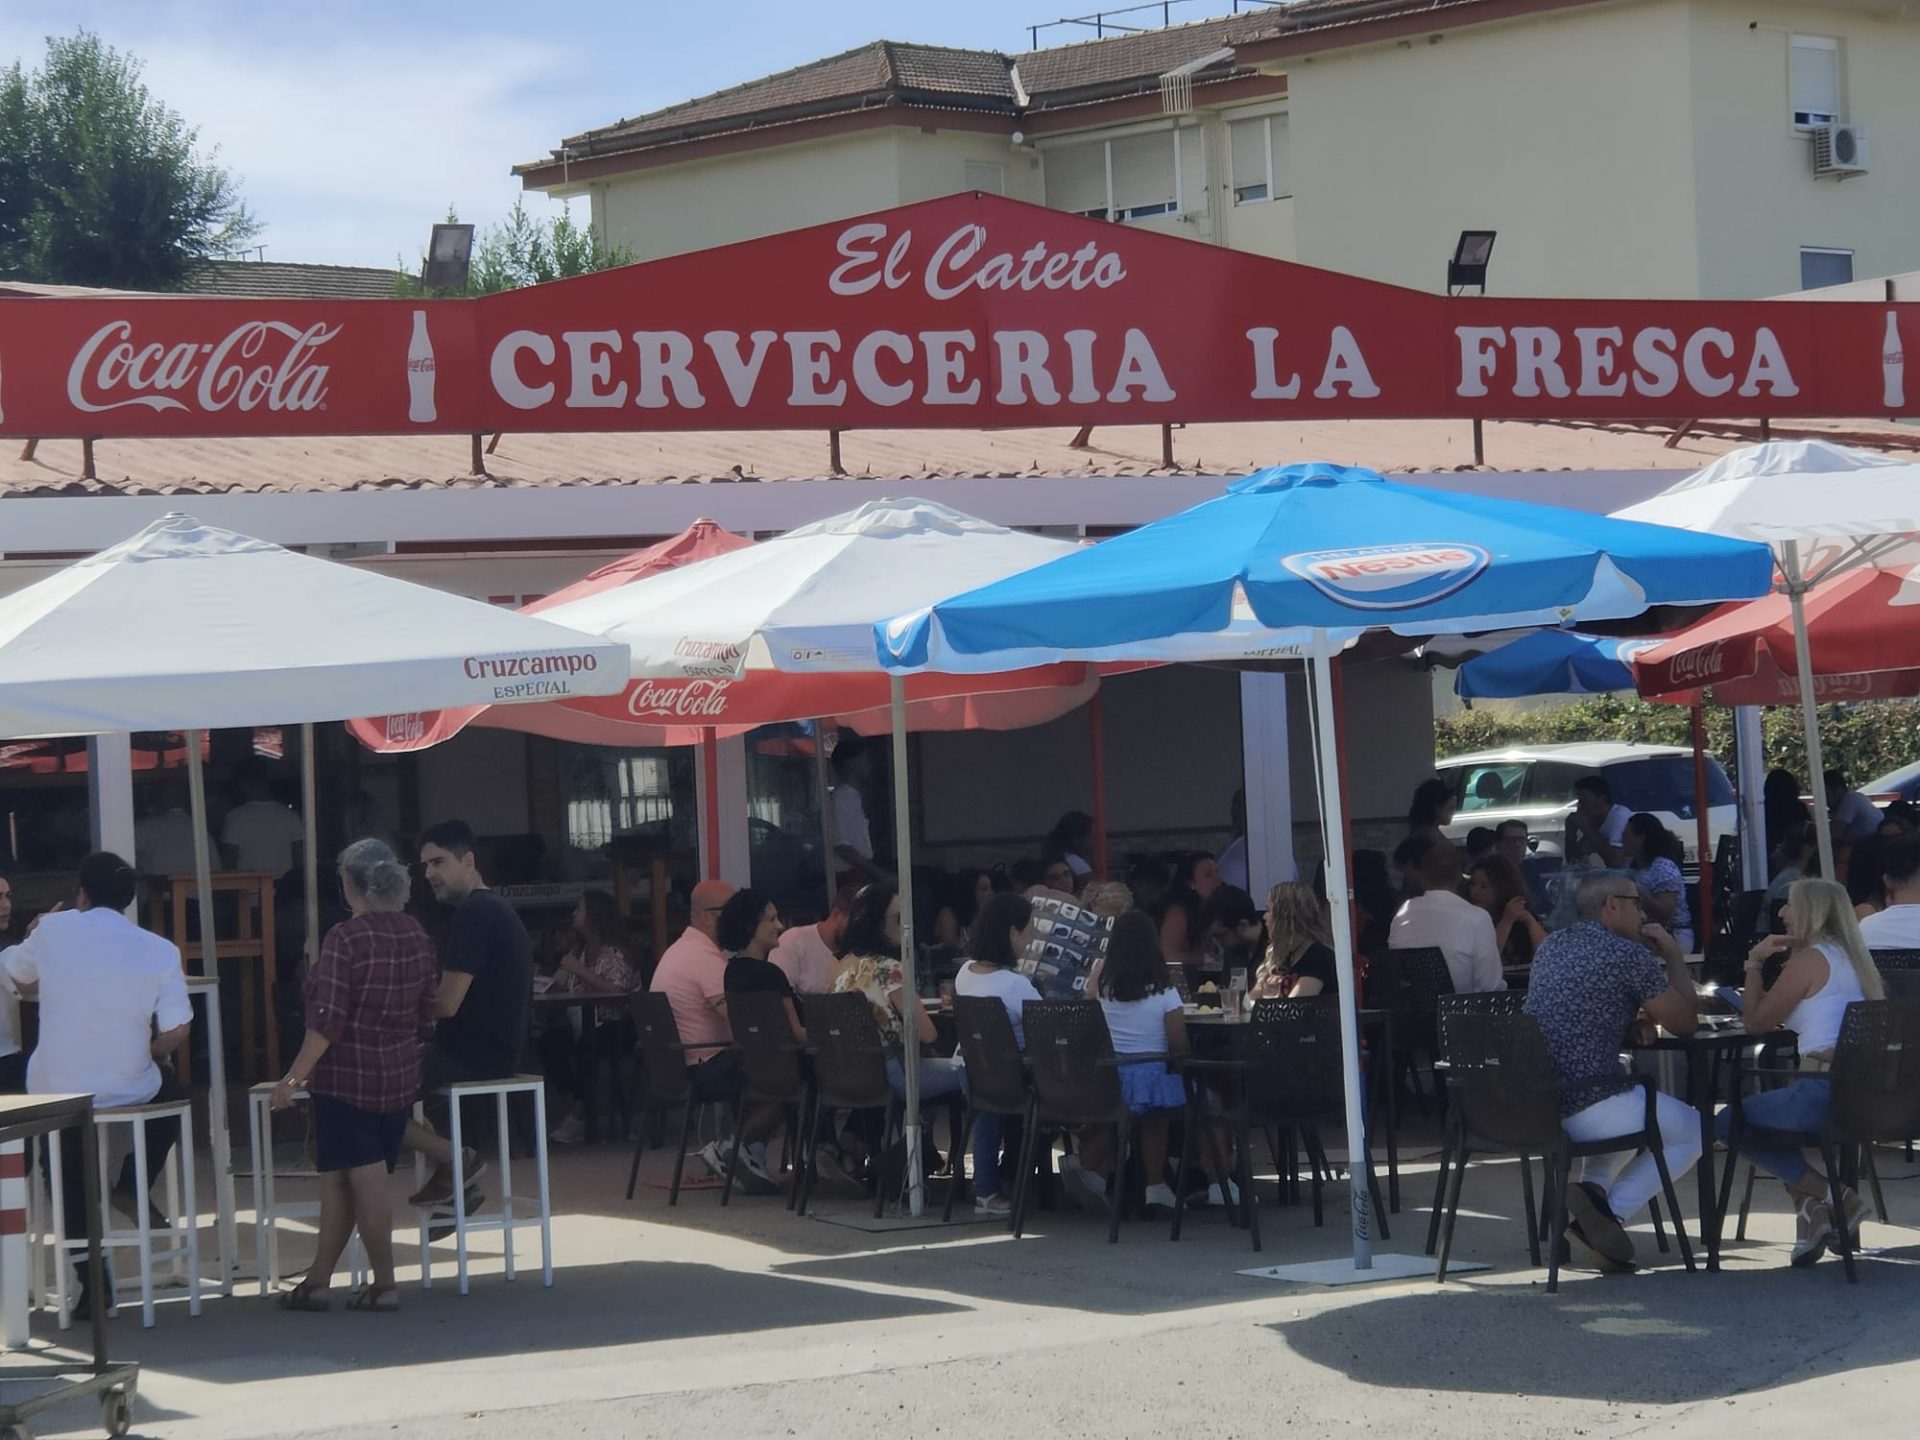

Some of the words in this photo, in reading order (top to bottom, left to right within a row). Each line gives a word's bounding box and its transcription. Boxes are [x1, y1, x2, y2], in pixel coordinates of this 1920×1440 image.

[828, 223, 912, 296] El
[924, 223, 1127, 301] Cateto
[67, 320, 344, 413] Coca-Cola
[490, 328, 1177, 410] CERVECERIA
[1246, 325, 1381, 400] LA
[1454, 326, 1799, 398] FRESCA
[464, 653, 597, 680] Cruzcampo
[493, 680, 571, 700] ESPECIAL
[628, 679, 732, 716] Coca-Cola
